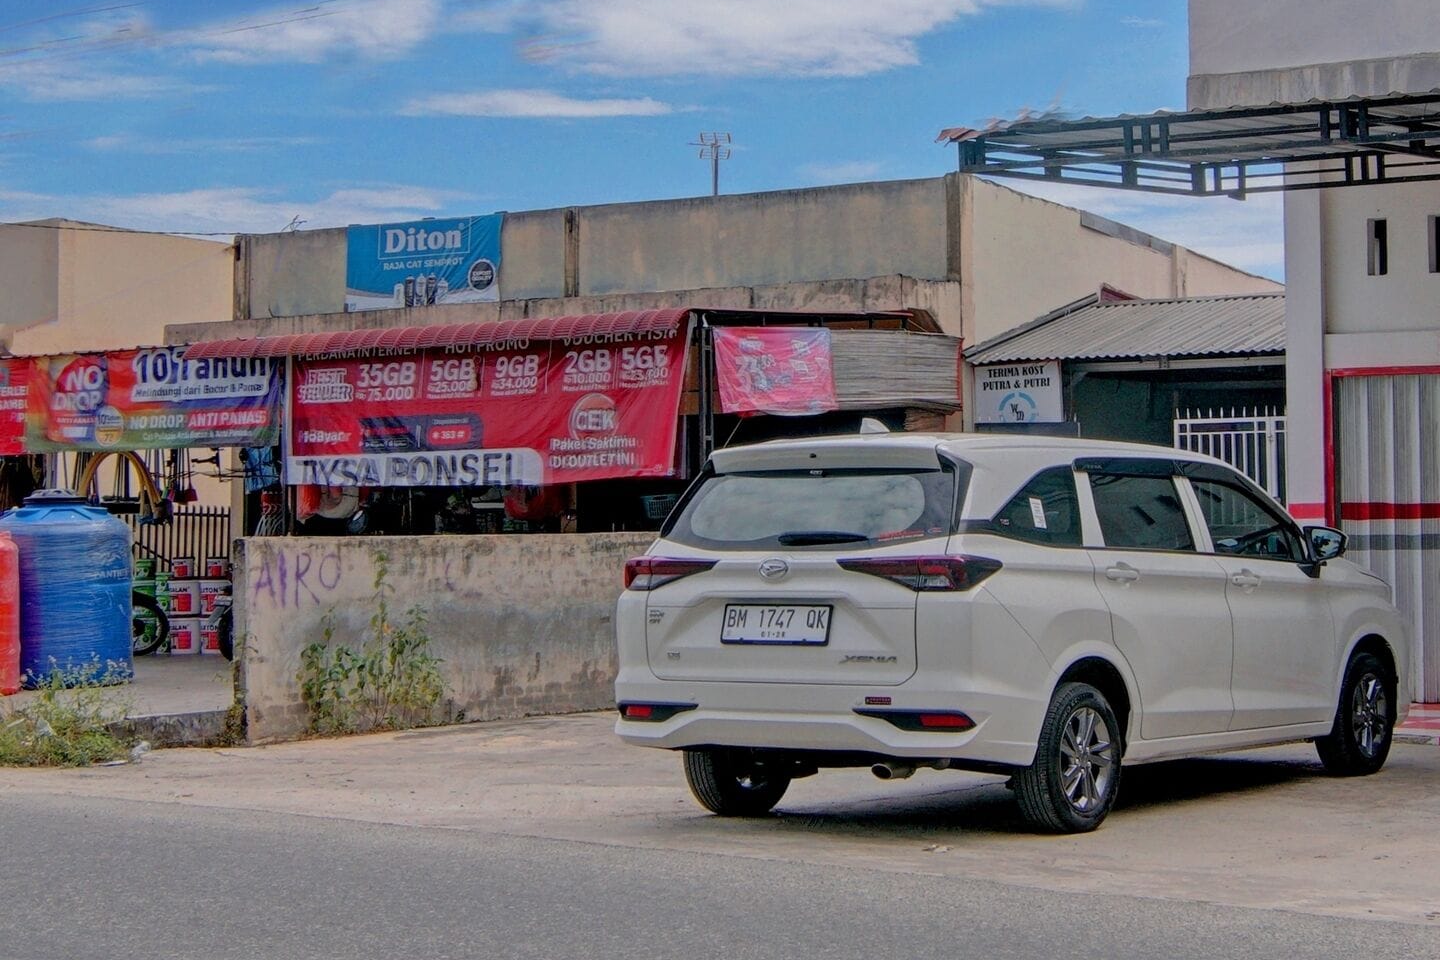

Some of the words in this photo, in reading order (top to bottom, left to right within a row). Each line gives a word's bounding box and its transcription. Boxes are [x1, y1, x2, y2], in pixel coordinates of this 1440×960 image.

[385, 227, 462, 253] Diton
[383, 261, 405, 271] RAJA
[406, 260, 422, 269] CAT
[424, 256, 465, 267] SEMPROT
[431, 359, 476, 381] 5GB
[495, 355, 539, 378] 9GB
[565, 349, 611, 374] 2GB
[988, 366, 1019, 378] TERIMA
[1022, 365, 1045, 376] KOST
[65, 365, 104, 391] NO
[357, 362, 416, 387] 35GB
[983, 381, 1011, 391] PUTRA
[1014, 380, 1021, 389] &
[1024, 377, 1050, 388] PUTRI
[52, 391, 101, 411] DROP
[367, 387, 414, 401] 75.000
[130, 416, 149, 429] NO
[152, 414, 184, 428] DROP
[188, 412, 219, 427] ANTI
[221, 410, 267, 425] PANAS
[576, 409, 615, 430] CEK
[727, 609, 748, 628] BM
[760, 609, 795, 628] 1747
[806, 609, 826, 629] QK
